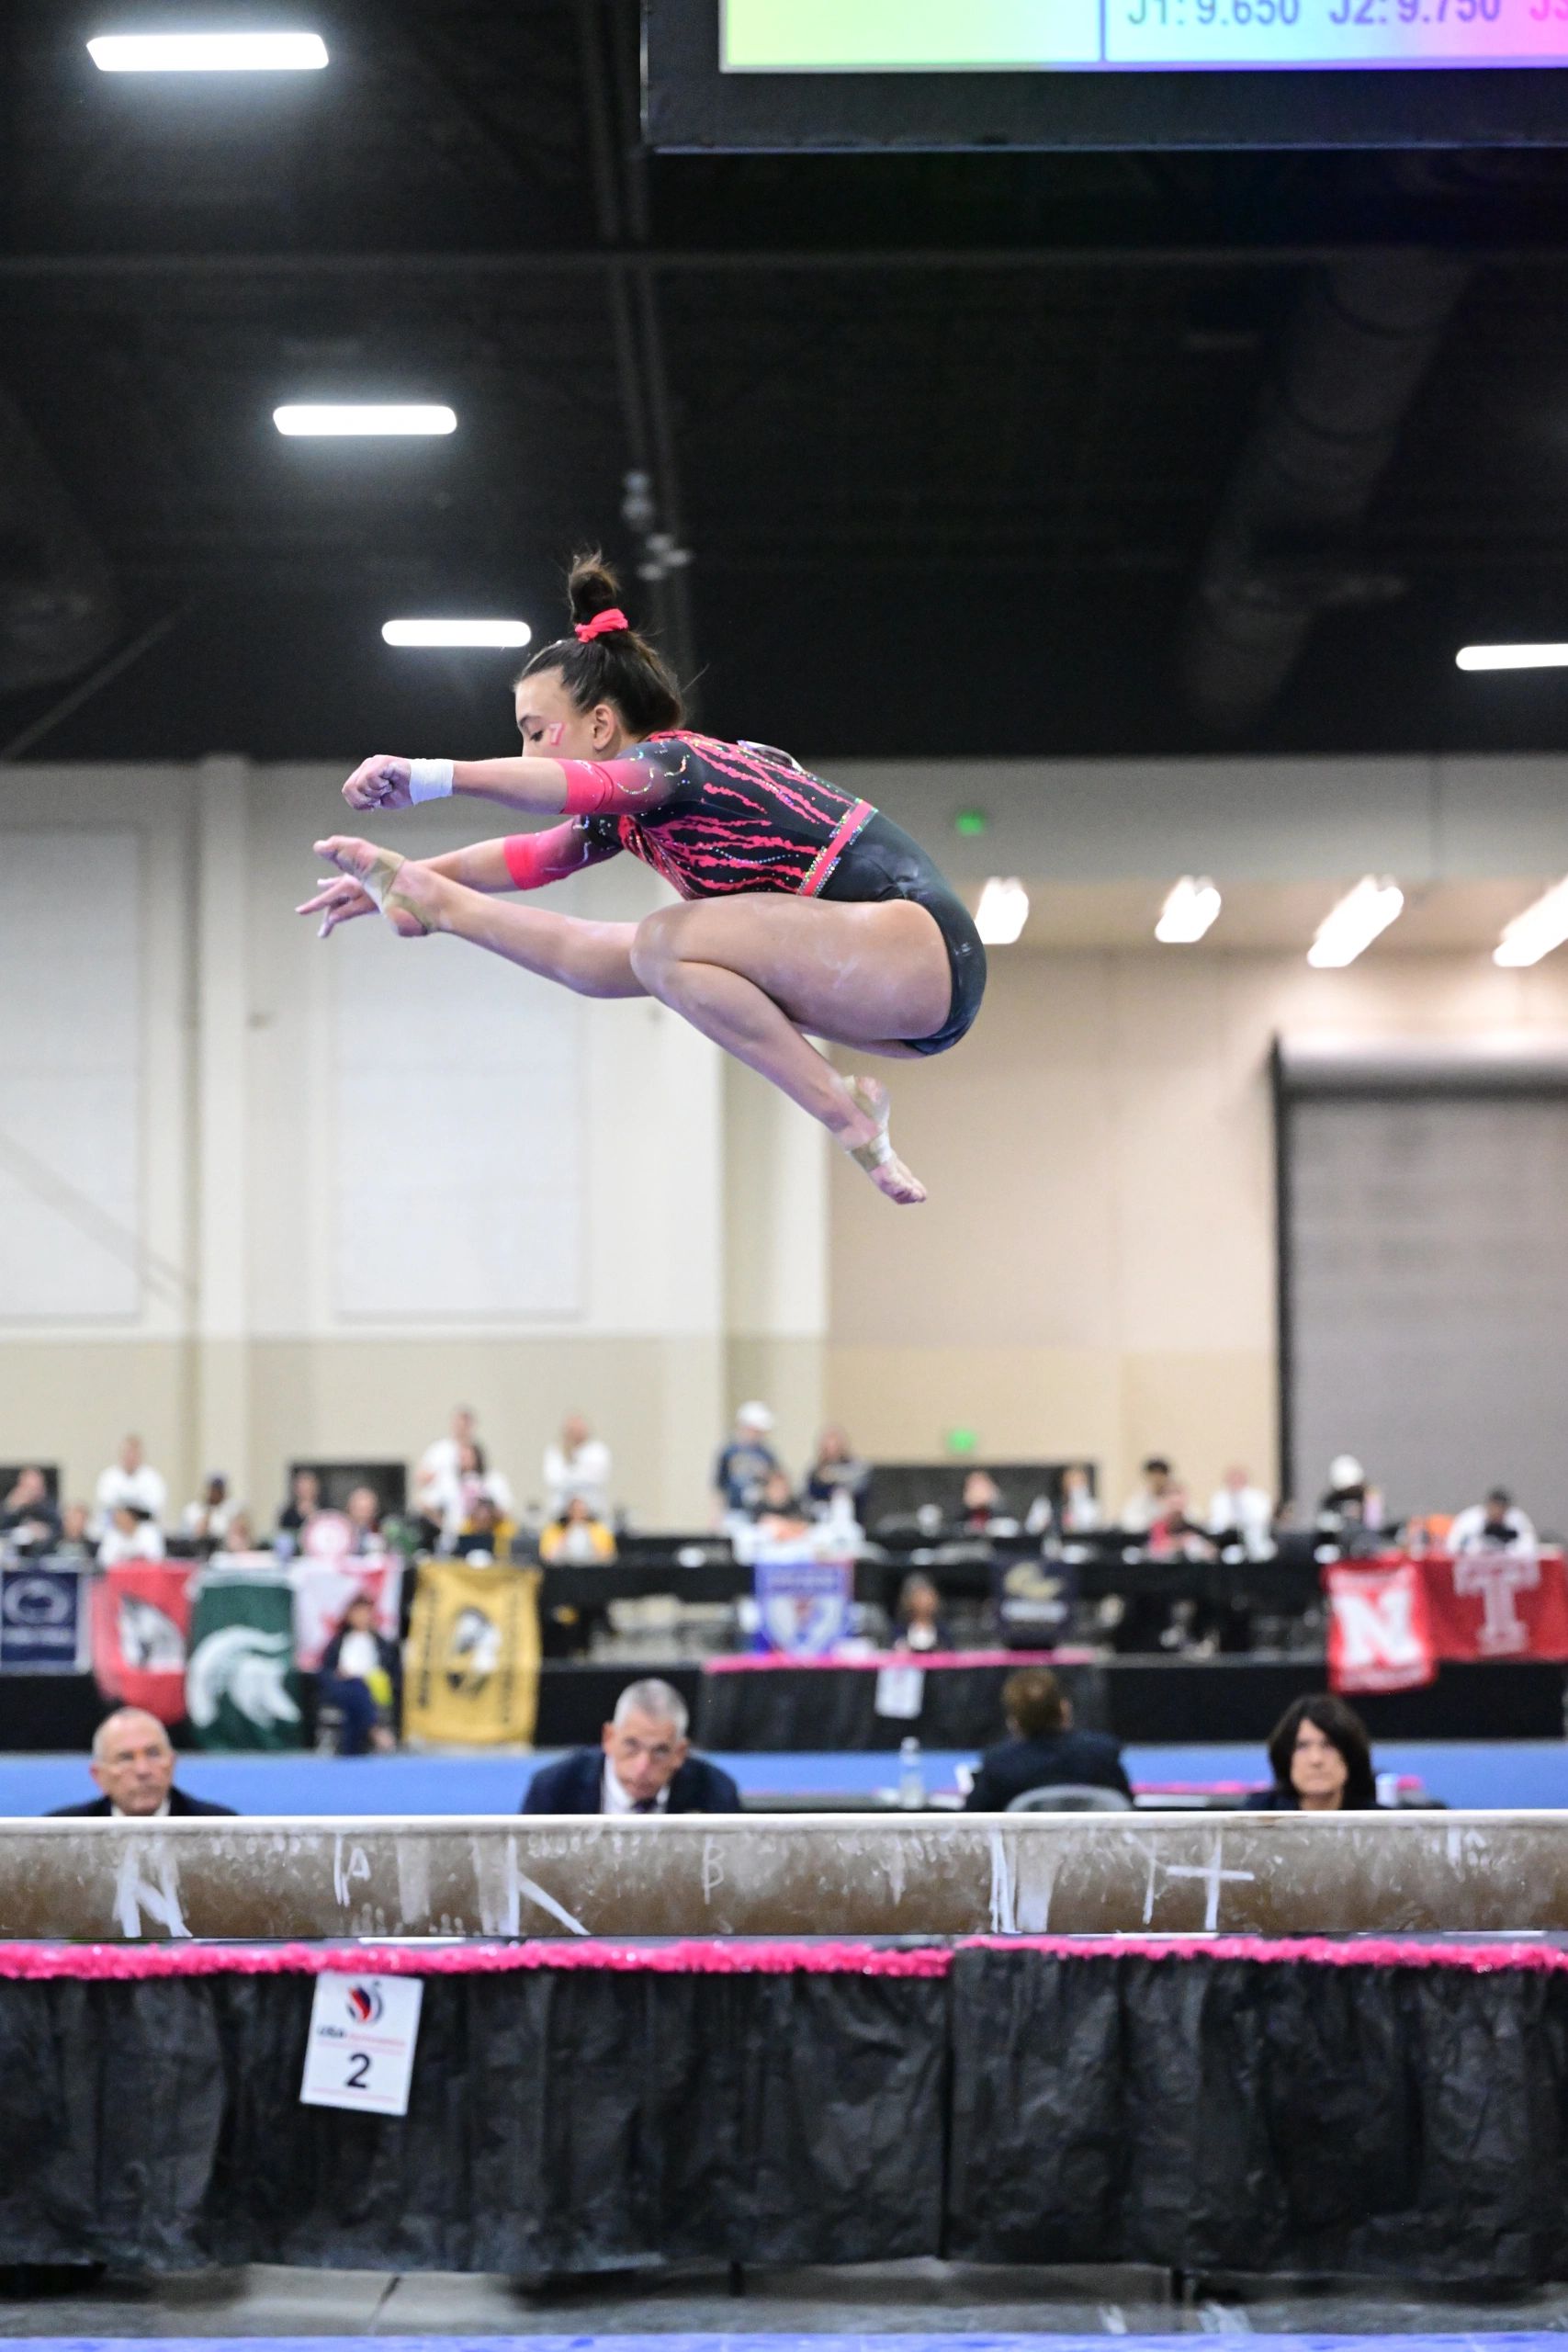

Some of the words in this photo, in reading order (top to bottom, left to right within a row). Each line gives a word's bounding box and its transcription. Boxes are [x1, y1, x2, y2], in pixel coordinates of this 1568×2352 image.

[1127, 0, 1185, 26] J1:
[1196, 0, 1300, 26] 9.650
[1397, 0, 1502, 23] 9.750
[1333, 1591, 1425, 1668] N
[344, 2052, 371, 2089] 2
